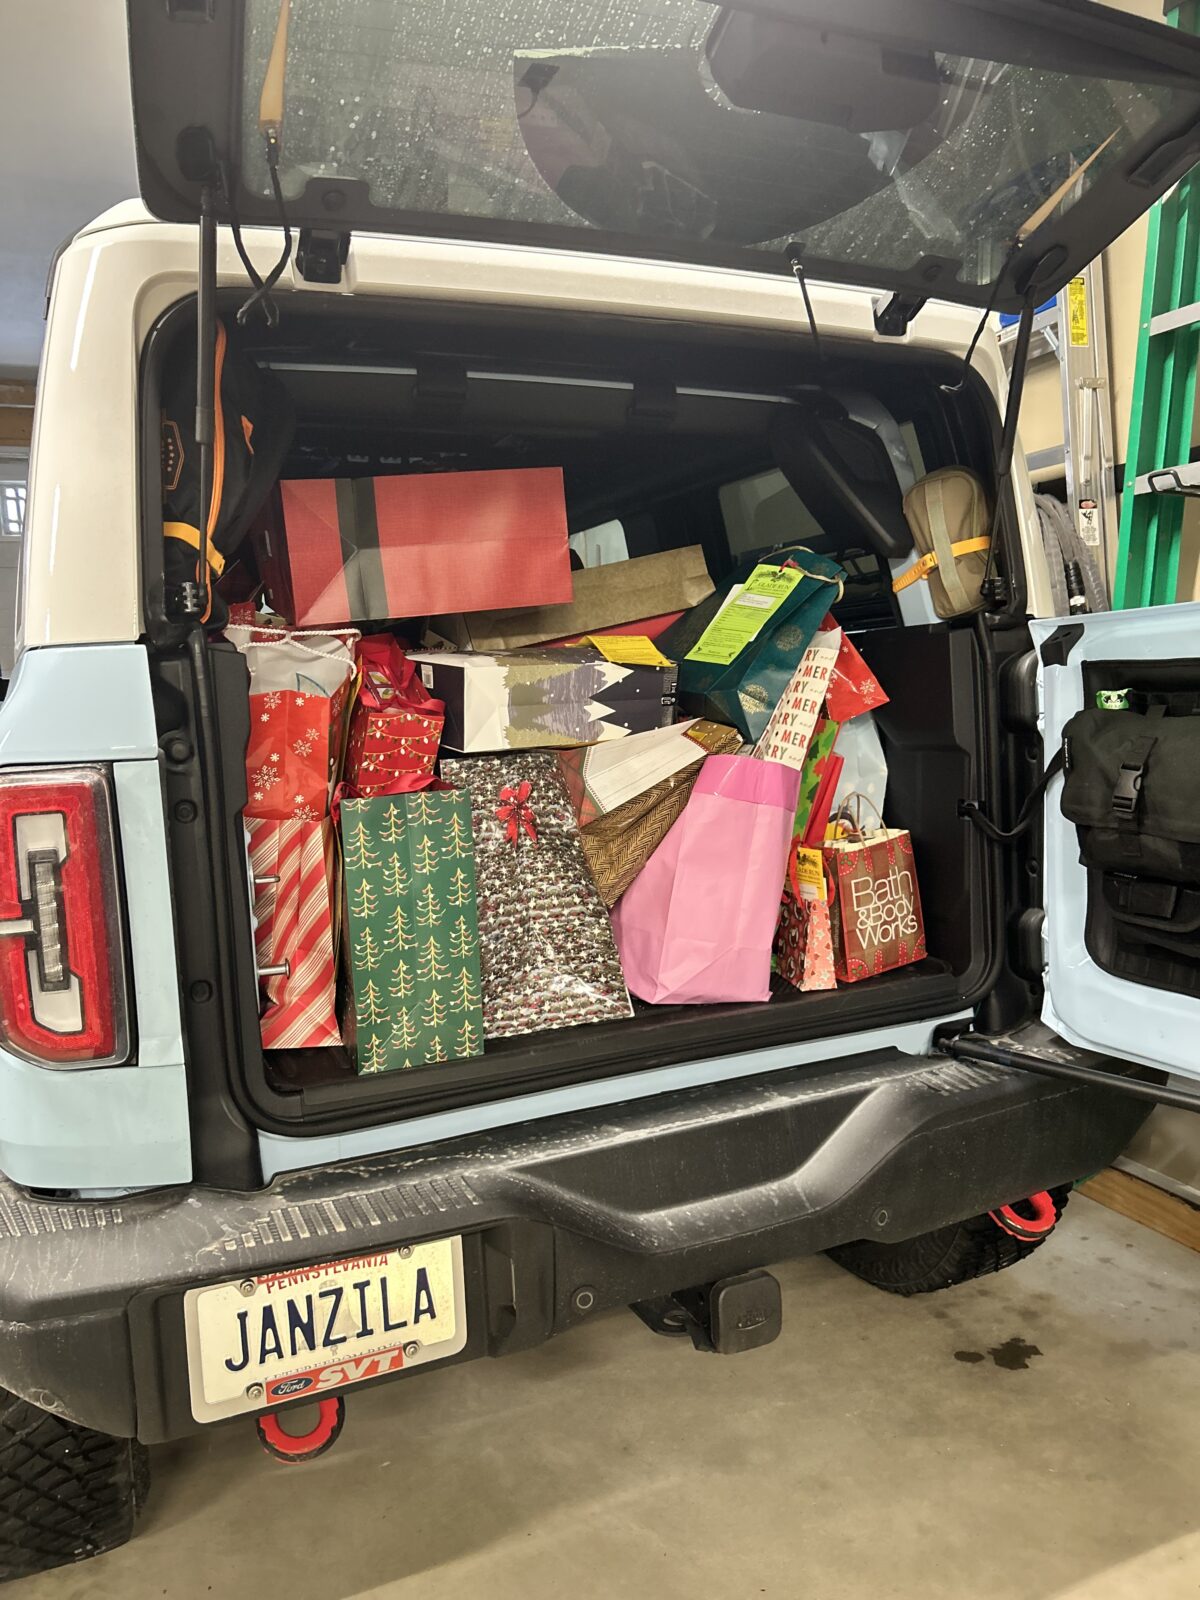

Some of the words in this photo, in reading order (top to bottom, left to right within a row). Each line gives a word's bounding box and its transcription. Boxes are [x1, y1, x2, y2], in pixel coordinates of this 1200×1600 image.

[851, 866, 913, 911] Bath
[856, 915, 918, 949] Works
[857, 894, 914, 929] &Body
[224, 1267, 437, 1372] JANZILA
[276, 1380, 306, 1395] Ford
[315, 1349, 400, 1389] SVT
